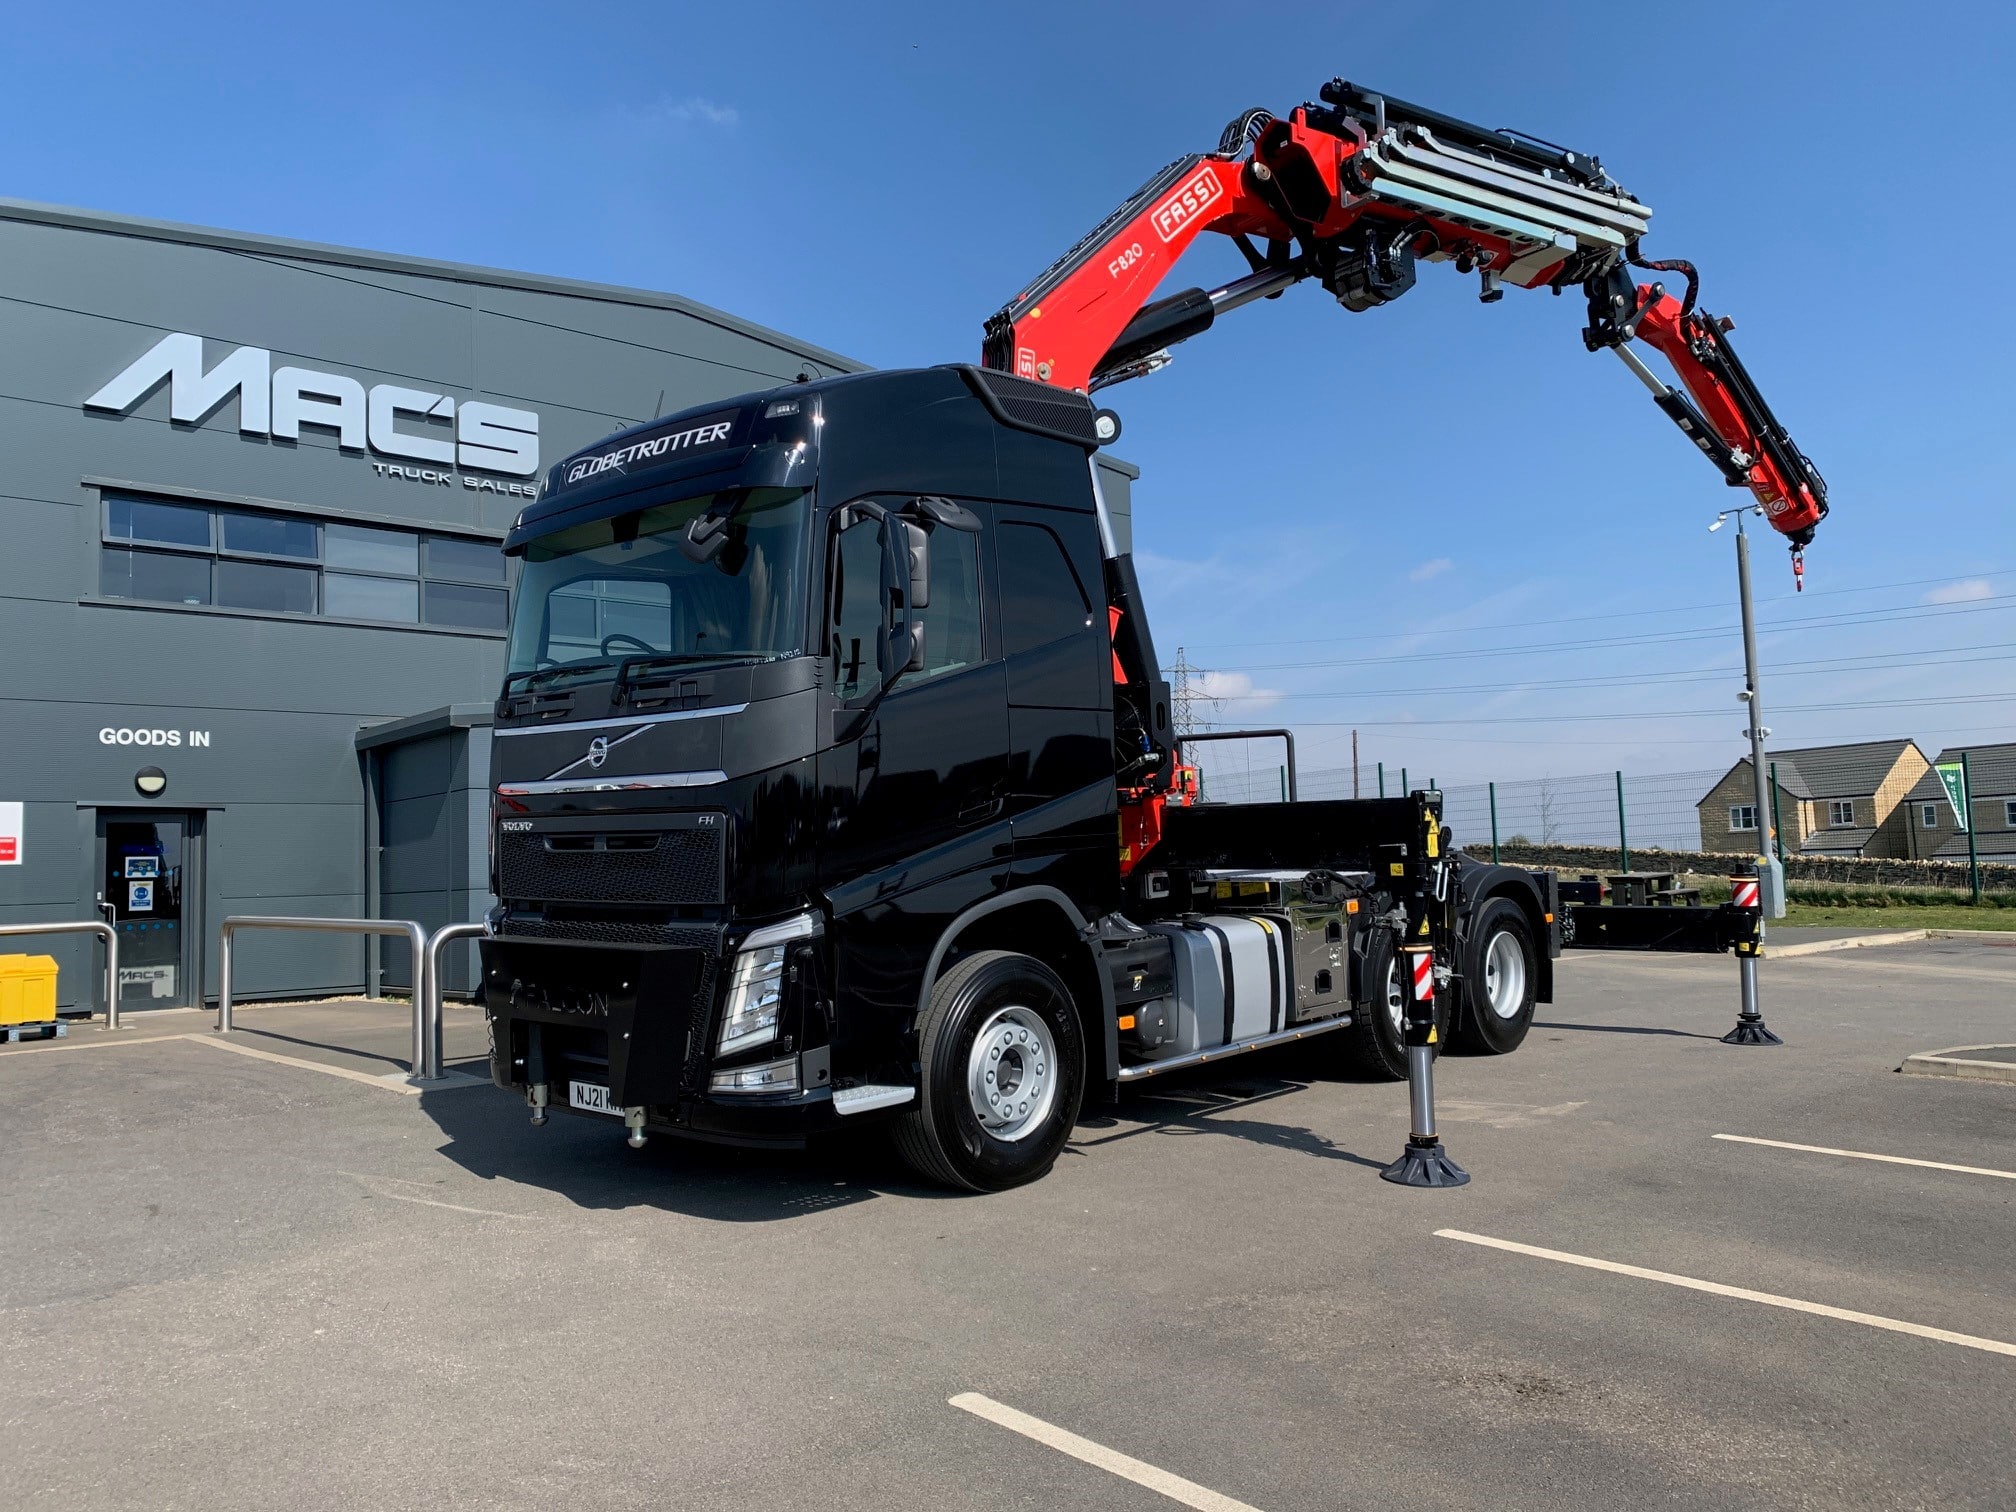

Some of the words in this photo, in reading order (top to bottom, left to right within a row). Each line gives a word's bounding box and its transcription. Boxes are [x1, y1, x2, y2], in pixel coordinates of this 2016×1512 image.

[1158, 175, 1217, 233] FASSI
[1108, 243, 1144, 279] F820
[568, 421, 732, 484] GLOBETROTTER
[373, 462, 452, 483] TRUCK
[463, 476, 537, 497] SALES
[98, 727, 182, 747] GOODS
[189, 730, 210, 748] IN
[501, 821, 534, 831] VOLVO
[698, 815, 715, 826] FH
[576, 1084, 603, 1108] NJ21
